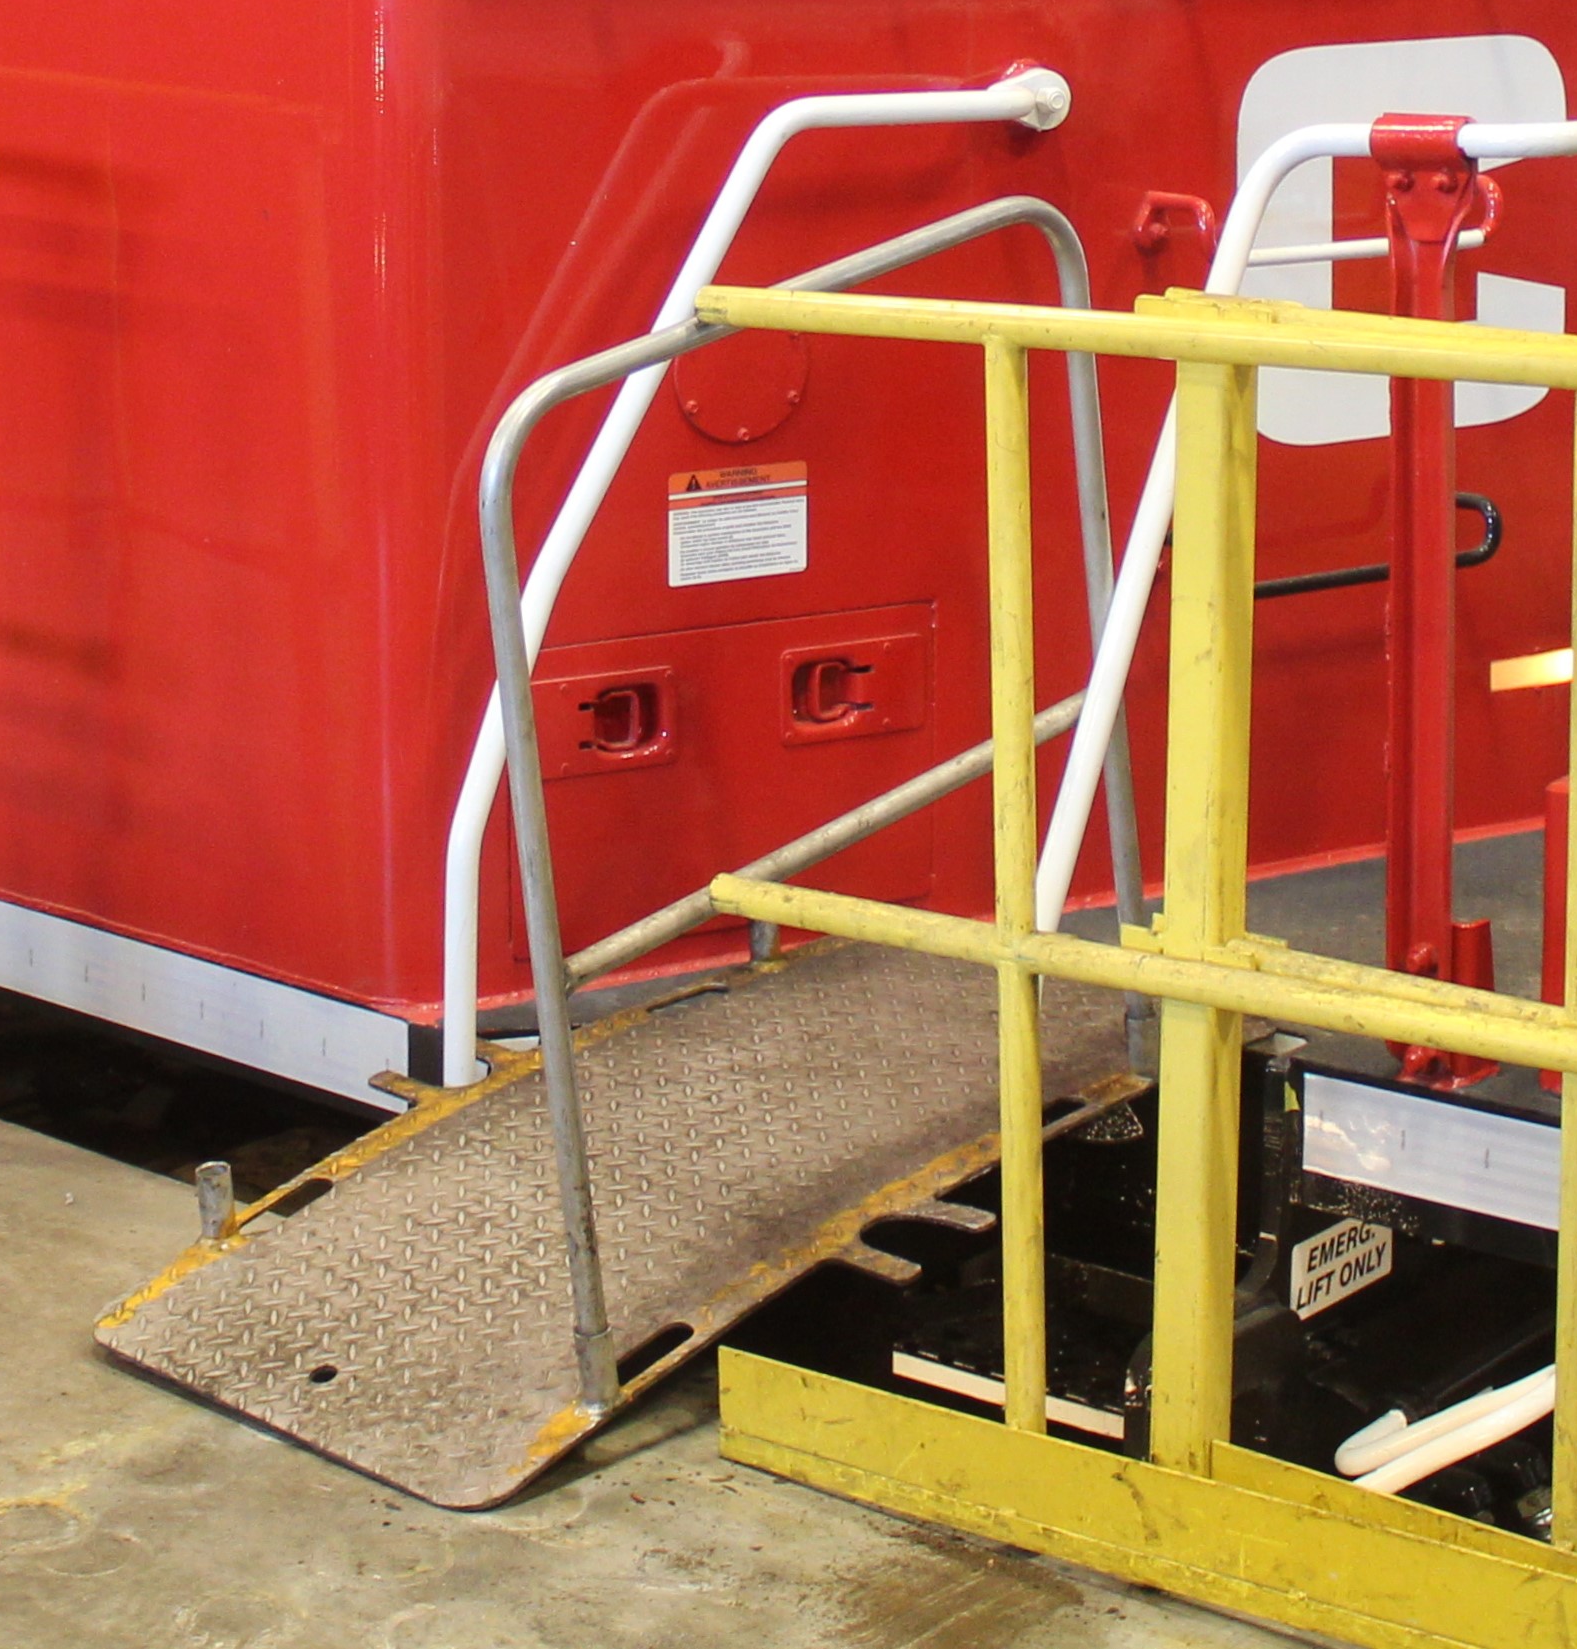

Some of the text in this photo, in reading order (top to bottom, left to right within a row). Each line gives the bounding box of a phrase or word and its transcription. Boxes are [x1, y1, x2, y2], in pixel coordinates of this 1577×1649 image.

[1296, 1241, 1387, 1311] LIFT ONLY
[1307, 1223, 1376, 1274] EMERG.
